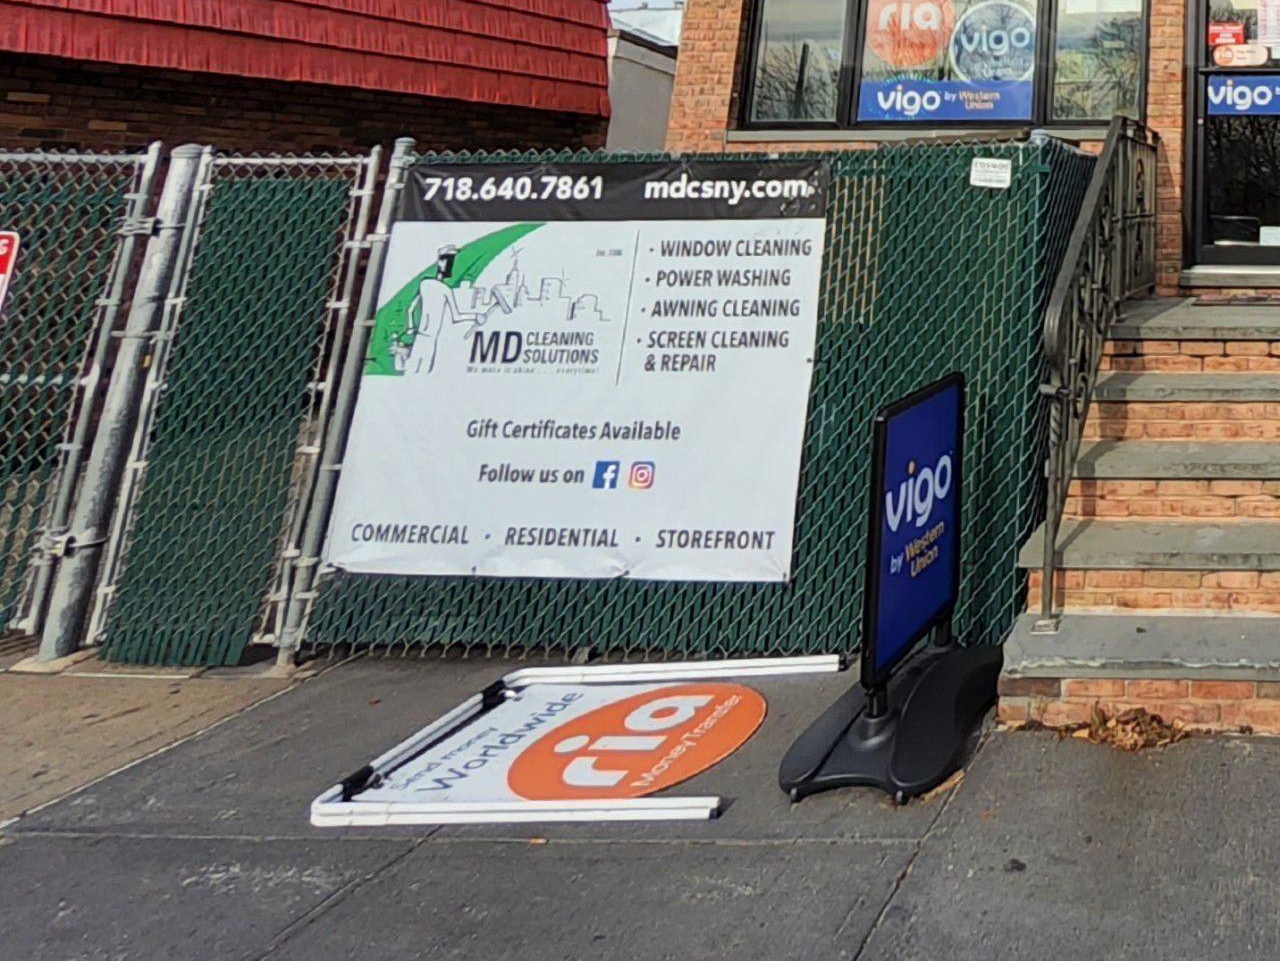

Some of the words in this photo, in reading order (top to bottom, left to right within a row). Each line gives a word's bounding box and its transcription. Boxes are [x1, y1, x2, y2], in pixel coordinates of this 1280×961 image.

[960, 23, 1030, 56] vigo
[877, 84, 941, 115] vigo
[944, 91, 957, 103] by
[1207, 78, 1272, 111] vigo
[422, 175, 603, 202] 718.640.7861
[644, 175, 809, 204] mdcsny.com
[660, 239, 732, 257] WINDOW
[735, 239, 812, 257] CLEANING
[656, 270, 714, 287] POWER
[716, 270, 791, 287] WASHING
[651, 300, 719, 318] AWNING
[722, 300, 801, 318] CLEANING
[469, 331, 523, 363] MD
[526, 332, 595, 346] CLEANING
[646, 331, 707, 348] SCREEN
[711, 331, 790, 348] CLEANING
[523, 348, 600, 364] SOLUTIONS
[644, 354, 657, 372] &
[660, 354, 717, 372] REPAIR
[466, 419, 498, 441] Gift
[501, 419, 597, 440] Certificates
[599, 419, 682, 440] Available
[478, 464, 535, 484] Follow
[538, 468, 559, 484] us
[562, 468, 585, 483] on
[885, 454, 952, 533] vigo
[350, 522, 470, 545] COMMERCIAL
[504, 526, 619, 548] RESIDENTIAL
[655, 529, 776, 550] STOREFRONT
[890, 552, 904, 575] by
[905, 521, 945, 563] Western
[911, 545, 939, 578] Union
[415, 691, 584, 793] Worldwide
[441, 726, 499, 761] money
[553, 694, 717, 788] ria
[629, 735, 697, 789] Money
